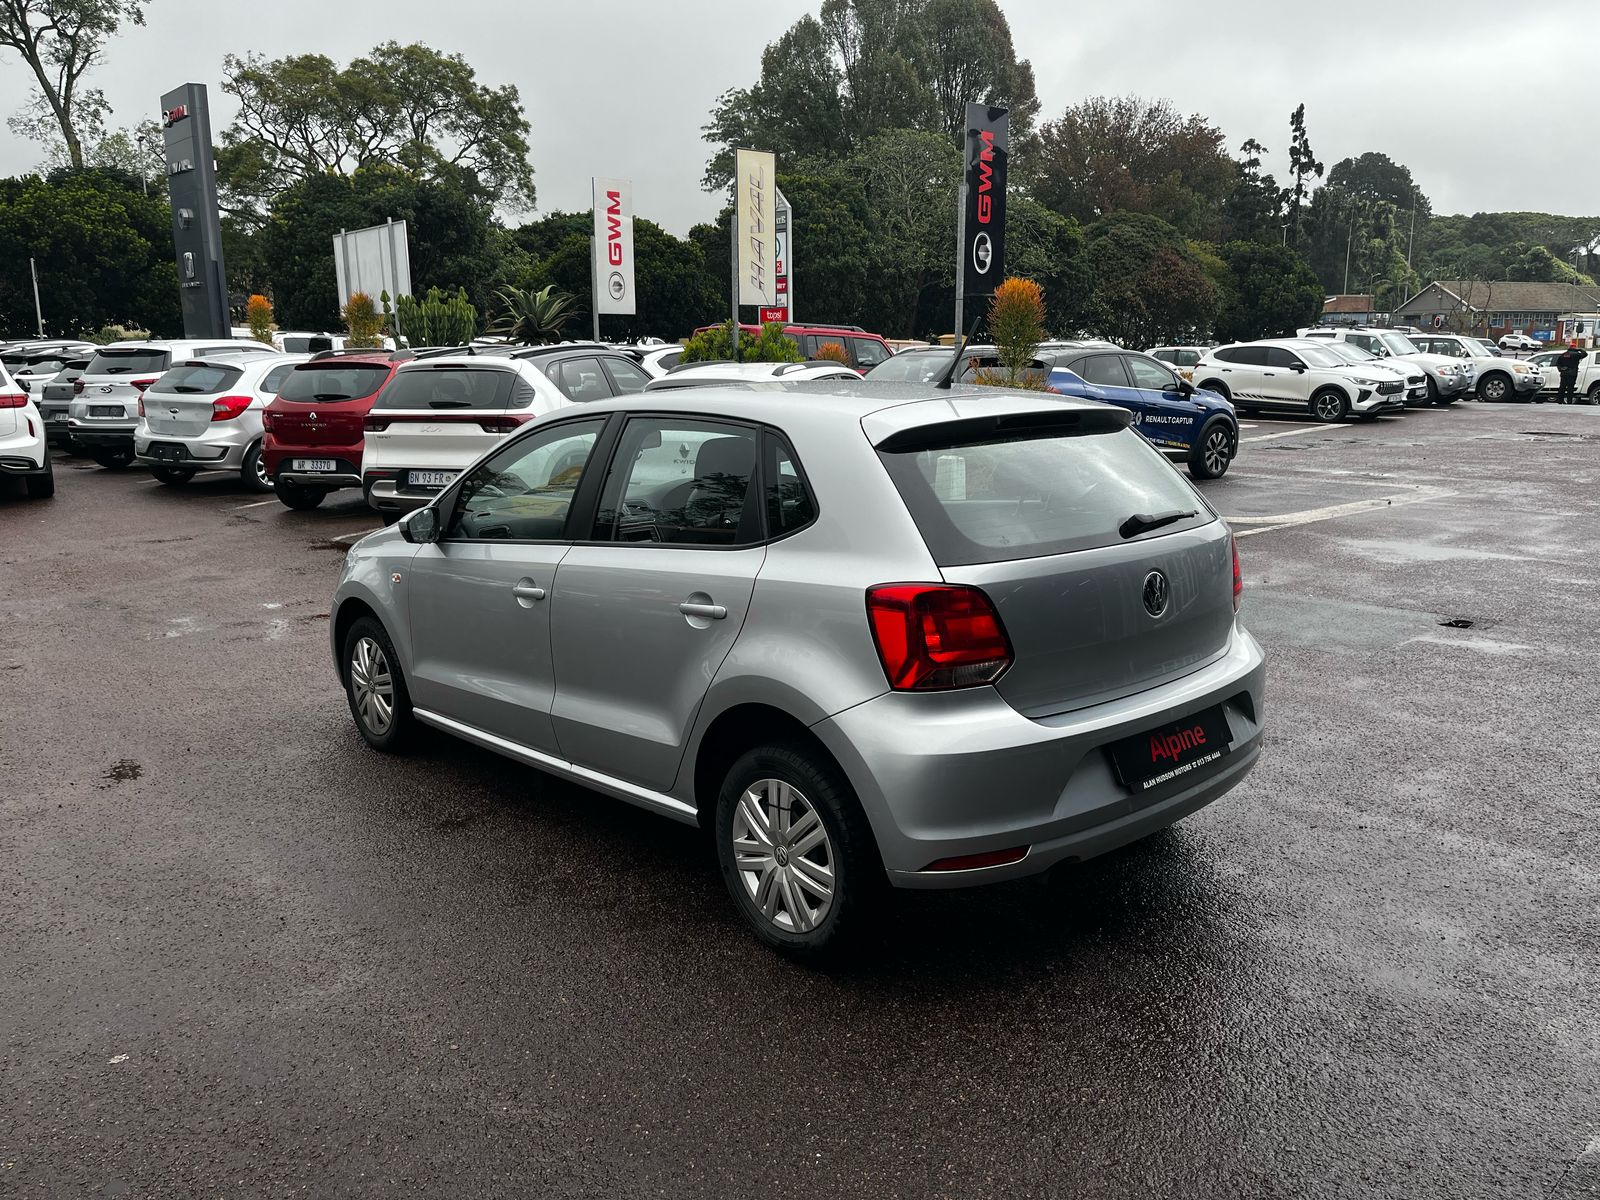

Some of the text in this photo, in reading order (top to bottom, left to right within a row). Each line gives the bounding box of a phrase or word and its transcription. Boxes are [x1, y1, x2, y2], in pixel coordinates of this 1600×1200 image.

[978, 131, 994, 224] GWM
[607, 191, 623, 266] GWM
[1145, 415, 1194, 425] RENAULT CAPTUR
[310, 460, 331, 470] 33370
[410, 472, 420, 484] BN
[422, 472, 432, 484] 93
[434, 472, 444, 484] FR
[1150, 725, 1207, 762] Alpine
[1143, 777, 1157, 790] ALAN
[1155, 770, 1175, 784] HUDSON
[1174, 763, 1193, 776] MOTORS
[1196, 757, 1205, 767] 013
